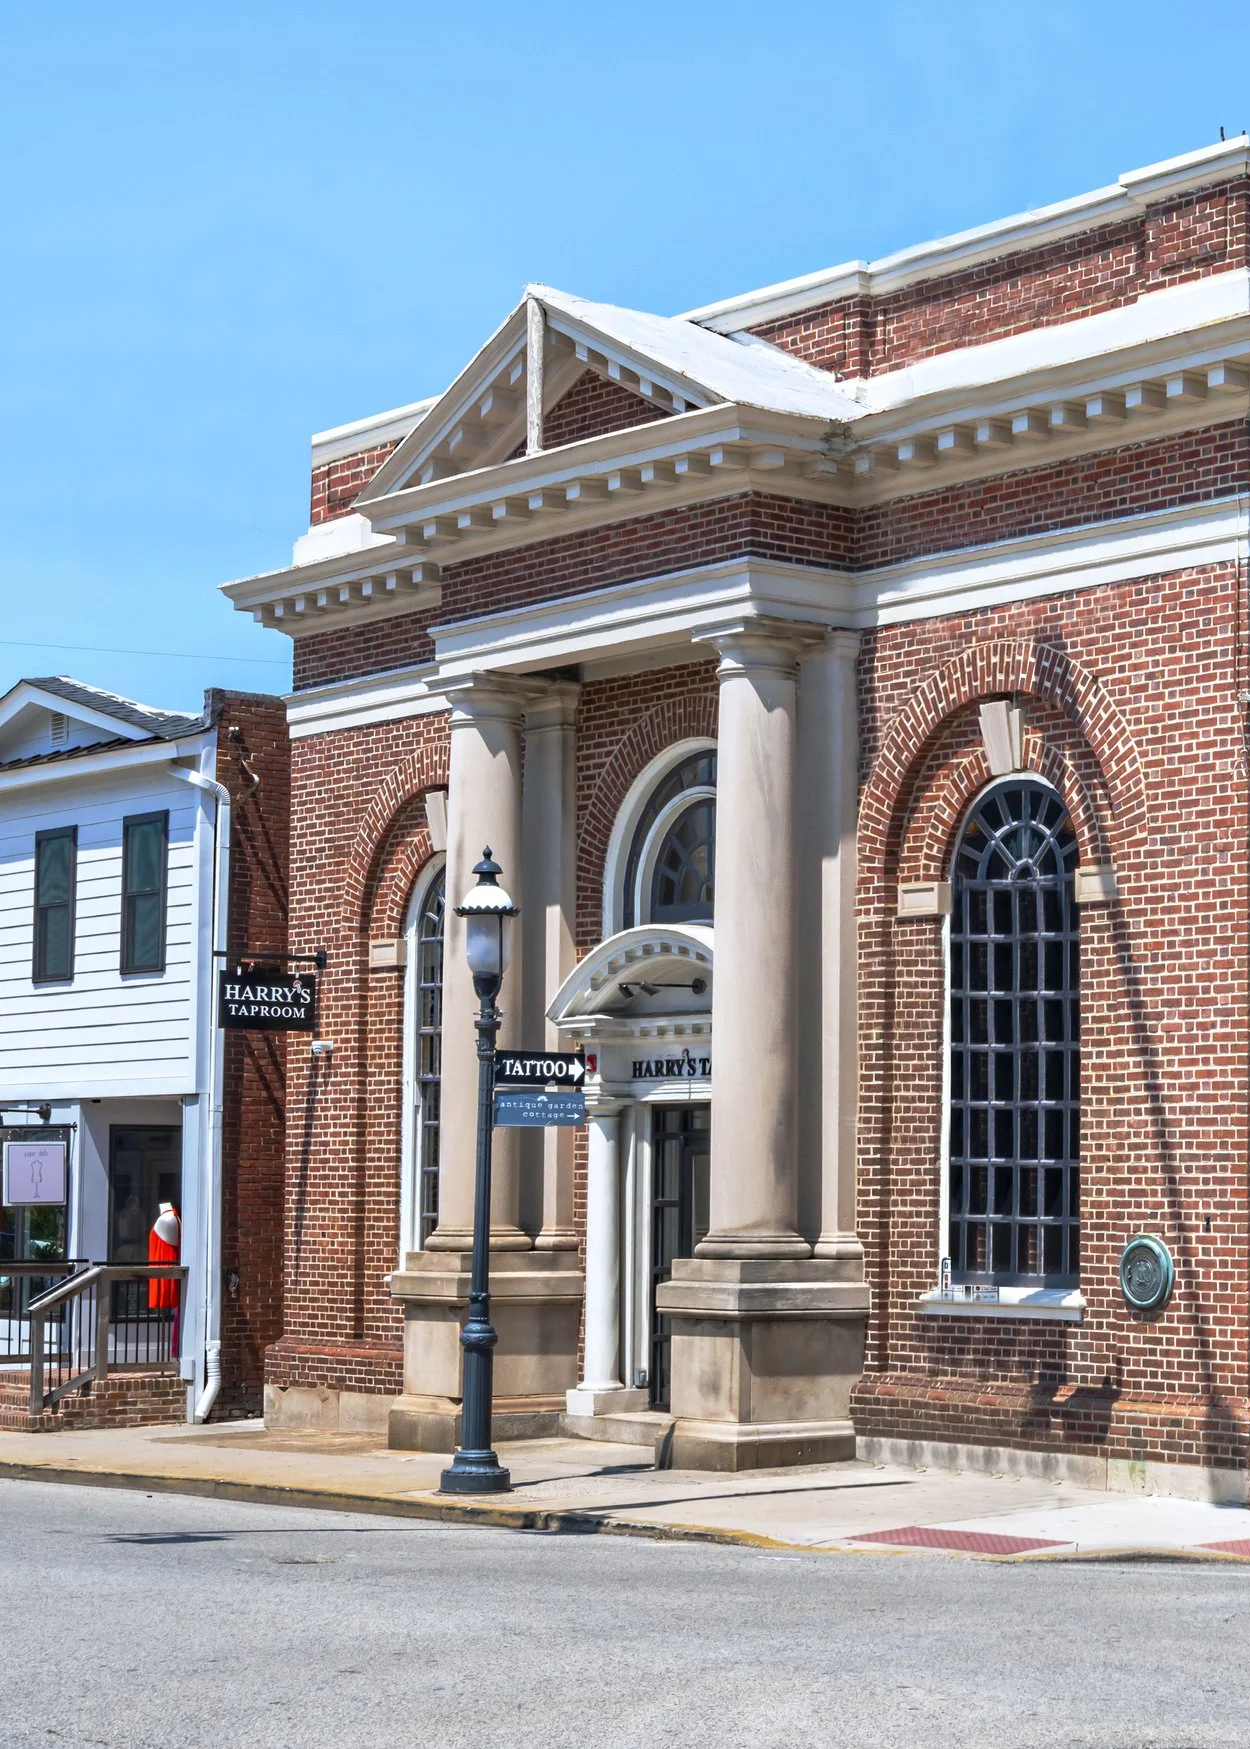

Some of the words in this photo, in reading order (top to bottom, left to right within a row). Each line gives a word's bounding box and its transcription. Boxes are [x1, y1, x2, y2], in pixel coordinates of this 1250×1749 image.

[224, 980, 311, 1004] HARRY'S
[228, 1003, 306, 1019] TAPROOM
[502, 1059, 567, 1077] TATTOO
[632, 1049, 697, 1078] HARRY'S
[500, 1101, 543, 1110] antique
[547, 1102, 584, 1110] garden
[522, 1111, 565, 1119] cottage
